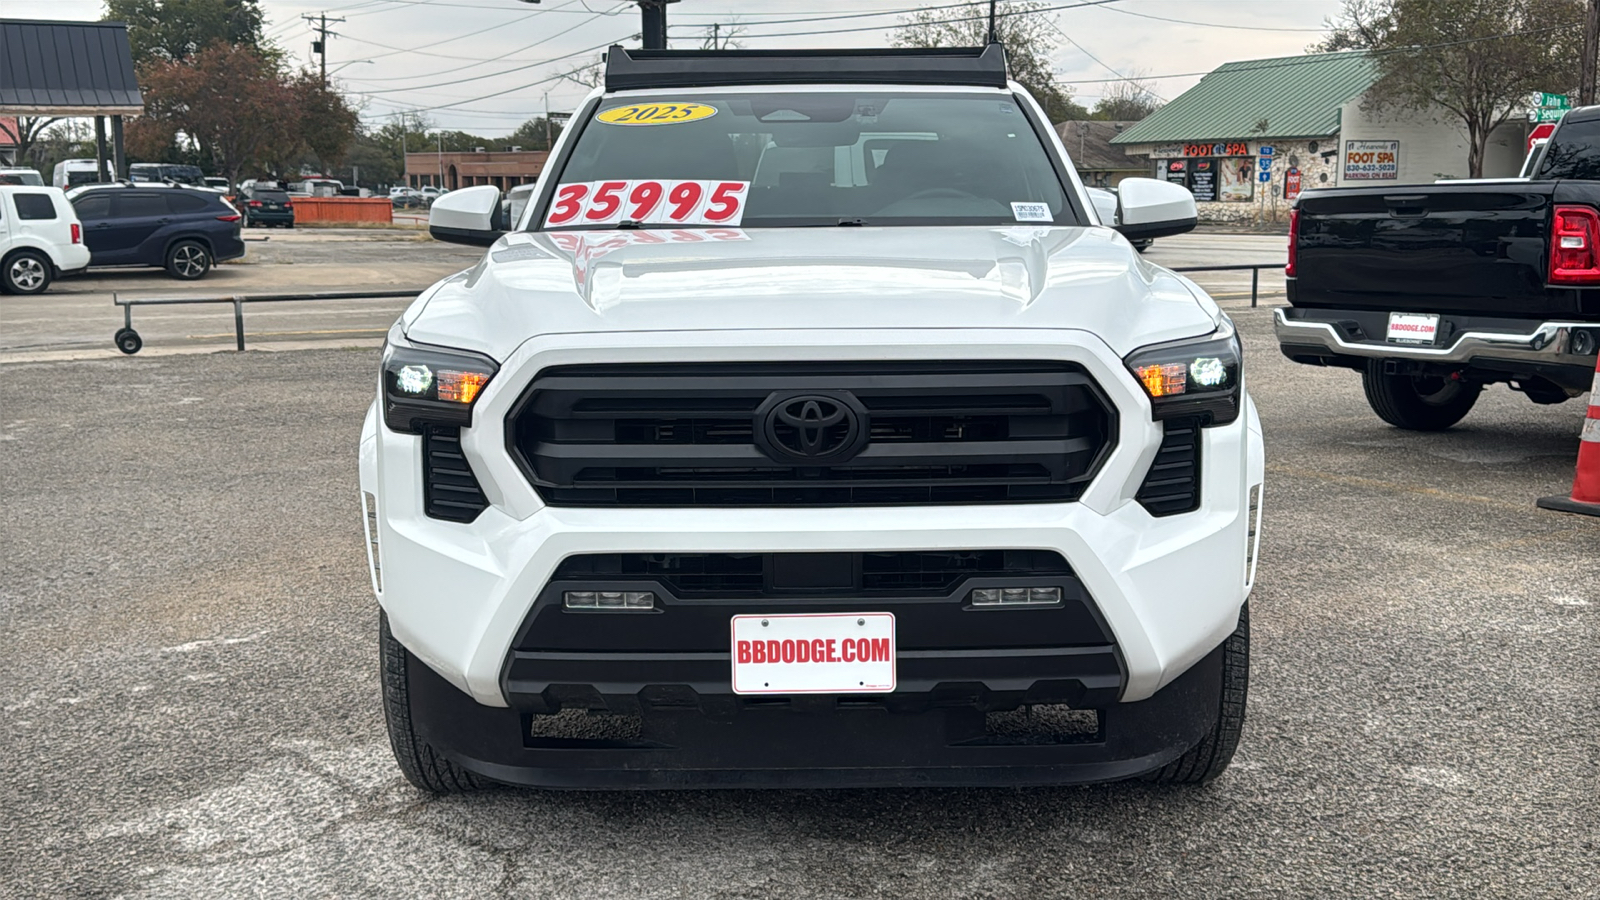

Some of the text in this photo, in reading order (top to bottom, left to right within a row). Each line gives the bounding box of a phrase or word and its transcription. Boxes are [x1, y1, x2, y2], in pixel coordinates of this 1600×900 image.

[1546, 95, 1561, 106] Jahn
[614, 106, 699, 121] 2025
[1184, 145, 1214, 156] FOOT
[1226, 143, 1248, 155] SPA
[1357, 141, 1388, 150] Heavenly
[1348, 152, 1394, 163] FOOT SPA
[1261, 160, 1270, 168] 35
[1287, 175, 1300, 184] FOOT
[548, 181, 746, 224] 35995
[1391, 324, 1434, 332] BBDODGE.COM
[737, 638, 890, 664] BBDODGE.COM
